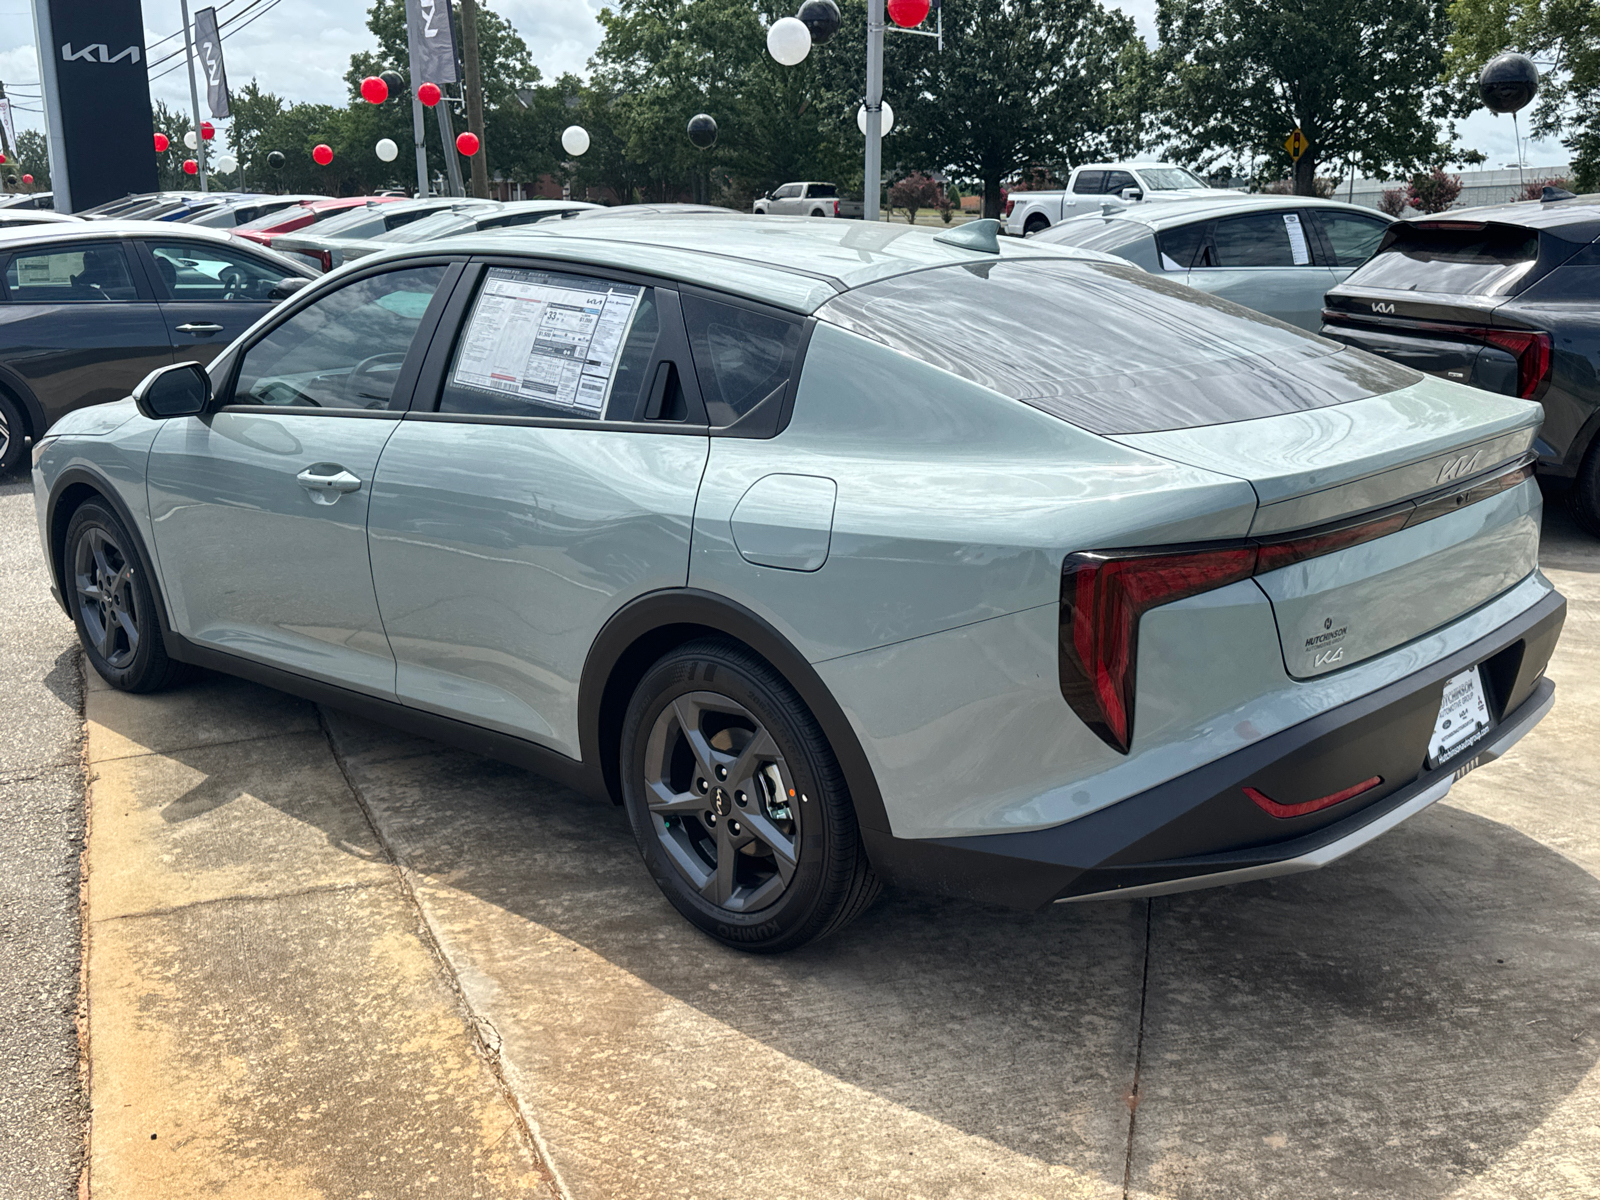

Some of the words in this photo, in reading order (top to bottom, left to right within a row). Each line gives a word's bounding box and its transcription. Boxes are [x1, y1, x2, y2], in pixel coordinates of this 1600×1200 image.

[61, 42, 140, 64] KIA
[547, 311, 558, 321] 33
[1371, 302, 1395, 314] KIA
[1436, 450, 1483, 484] KIA
[1305, 626, 1347, 647] HUTCHINSON
[1313, 647, 1343, 668] K4
[1441, 678, 1474, 709] UTCHINSON
[717, 919, 781, 941] KUMHO
